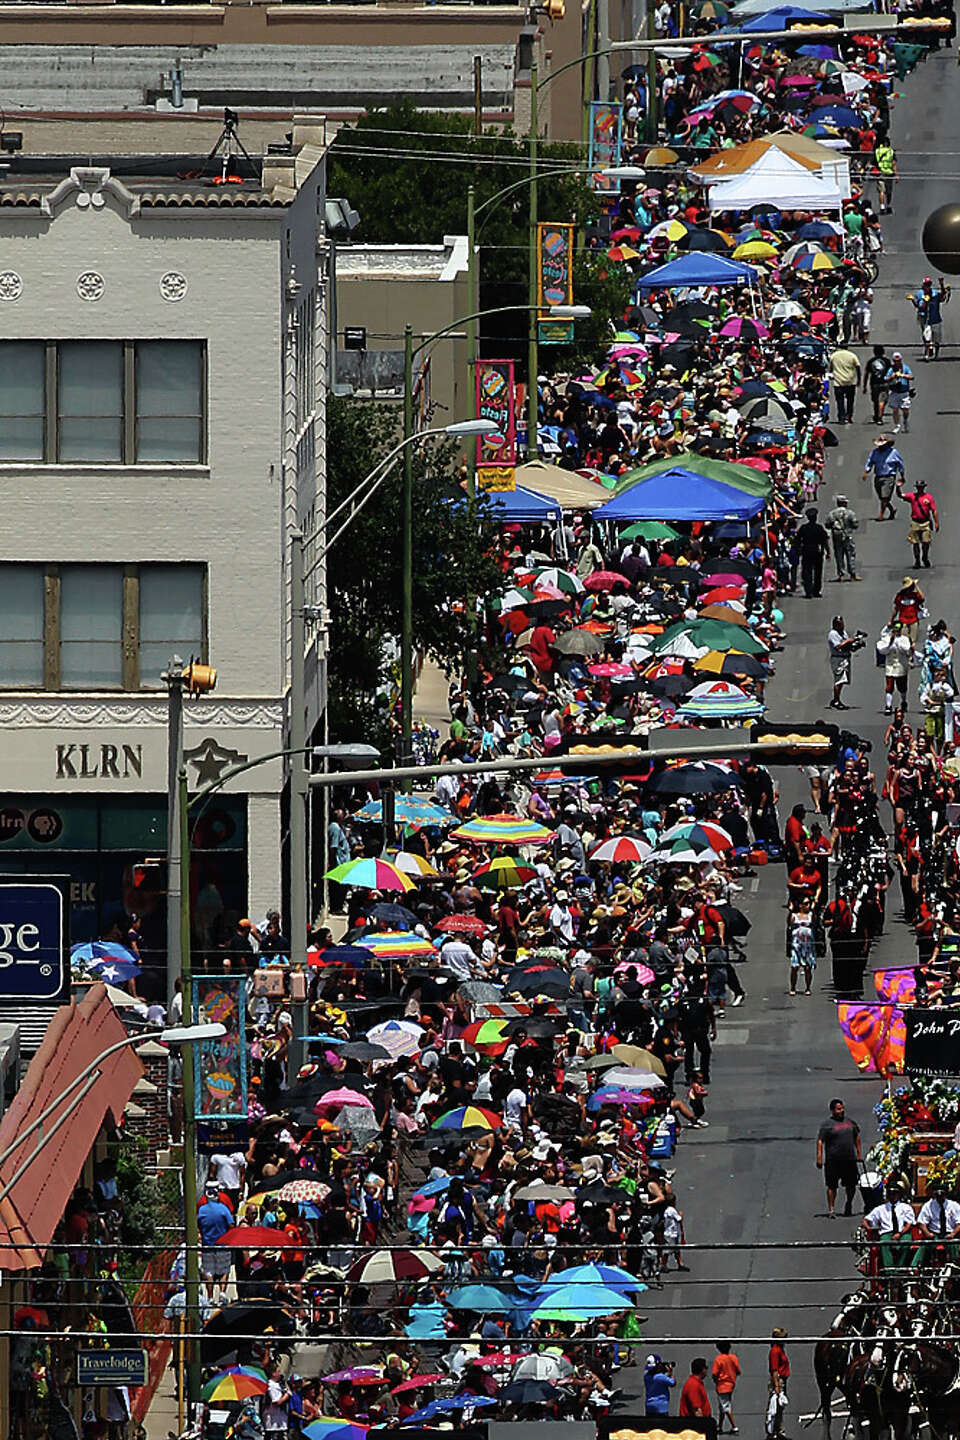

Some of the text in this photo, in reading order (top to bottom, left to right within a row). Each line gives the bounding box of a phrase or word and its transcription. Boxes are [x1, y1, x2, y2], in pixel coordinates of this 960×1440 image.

[55, 744, 142, 779] KLRN
[913, 1021, 945, 1038] John
[81, 1356, 142, 1371] Travelodge
